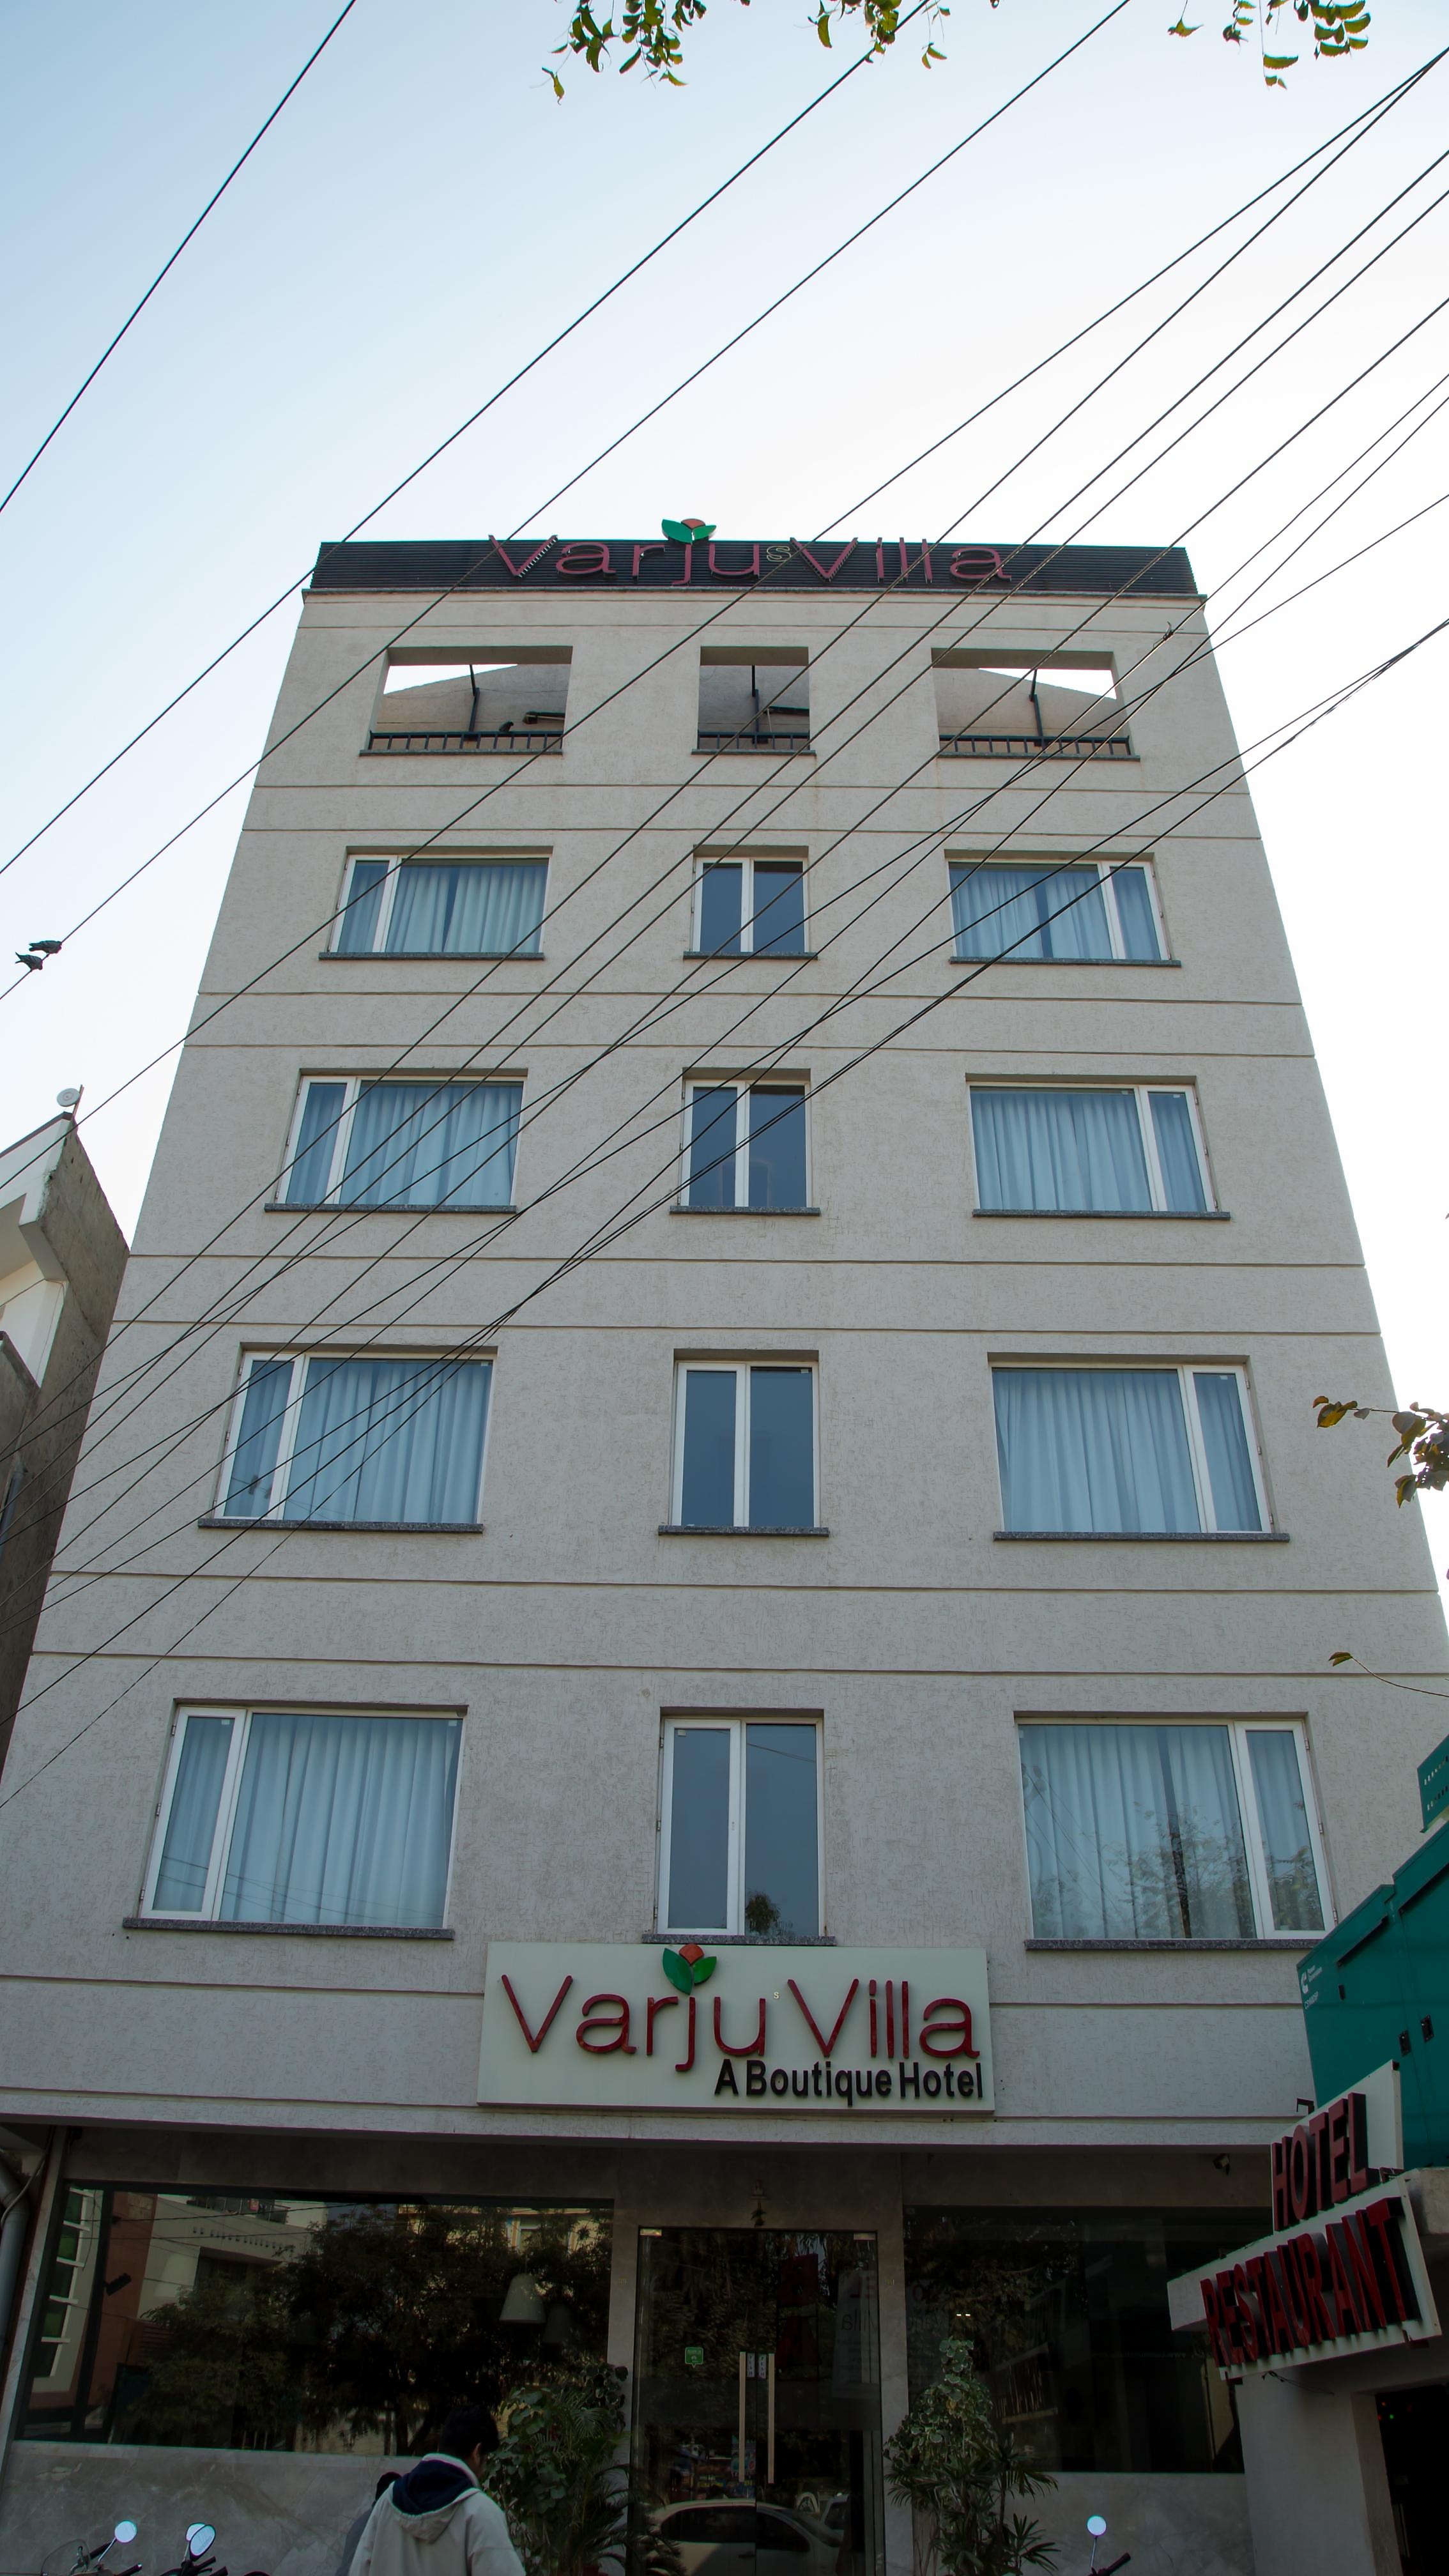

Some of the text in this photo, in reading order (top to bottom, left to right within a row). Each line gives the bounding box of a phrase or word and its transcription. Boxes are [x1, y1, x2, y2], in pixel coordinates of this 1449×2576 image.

[488, 534, 760, 586] Varju
[789, 537, 1013, 584] Villa
[501, 1974, 766, 2072] Varju
[787, 1979, 981, 2058] Villa
[714, 2058, 983, 2107] A Boutique Hotel
[1271, 2092, 1370, 2232] HOTEL
[1200, 2196, 1409, 2368] RESTAURANT
